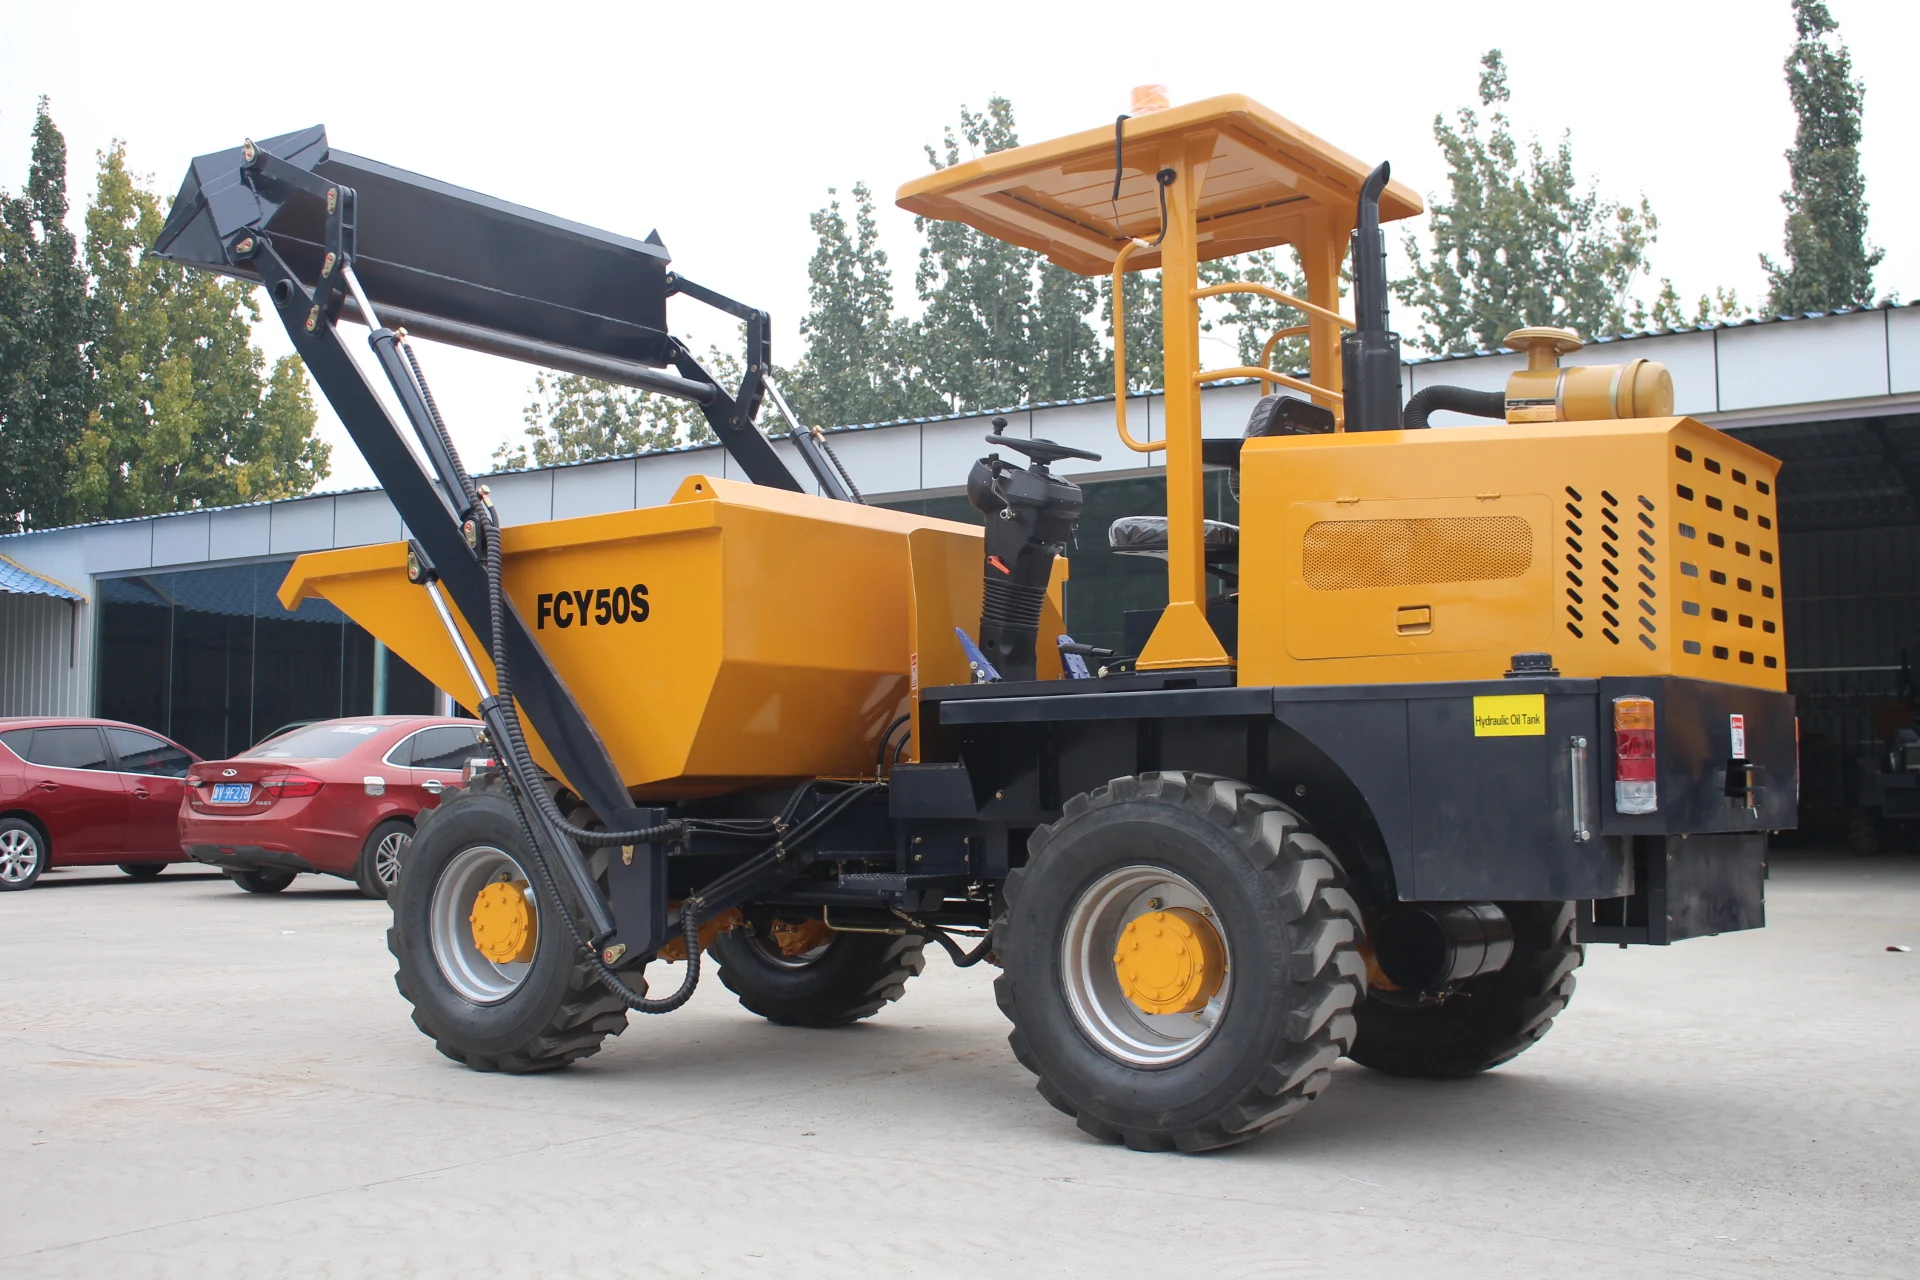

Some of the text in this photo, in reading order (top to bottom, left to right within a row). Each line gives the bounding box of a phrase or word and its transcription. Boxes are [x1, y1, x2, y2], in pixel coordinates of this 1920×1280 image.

[537, 583, 650, 630] FCY50S
[1475, 713, 1541, 728] Hydraulic Oil Tank
